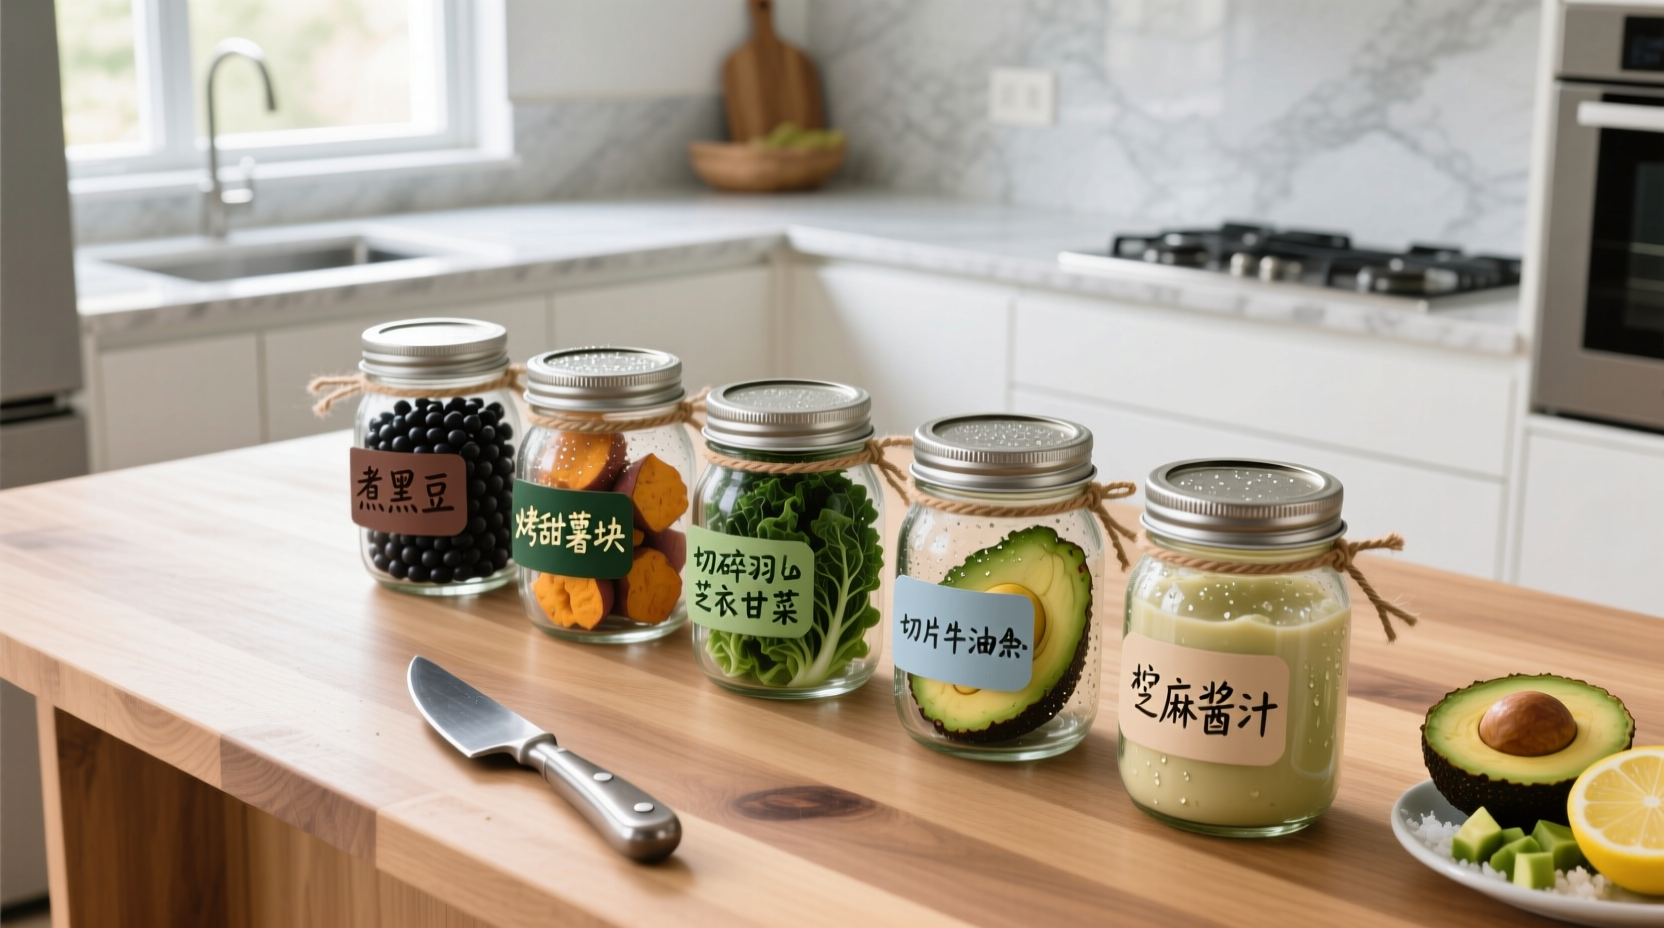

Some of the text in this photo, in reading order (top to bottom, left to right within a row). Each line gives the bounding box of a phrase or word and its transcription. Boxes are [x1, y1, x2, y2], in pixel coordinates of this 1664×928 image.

[357, 465, 455, 514] 煮黑豆
[515, 505, 626, 554] 烤甜薯块
